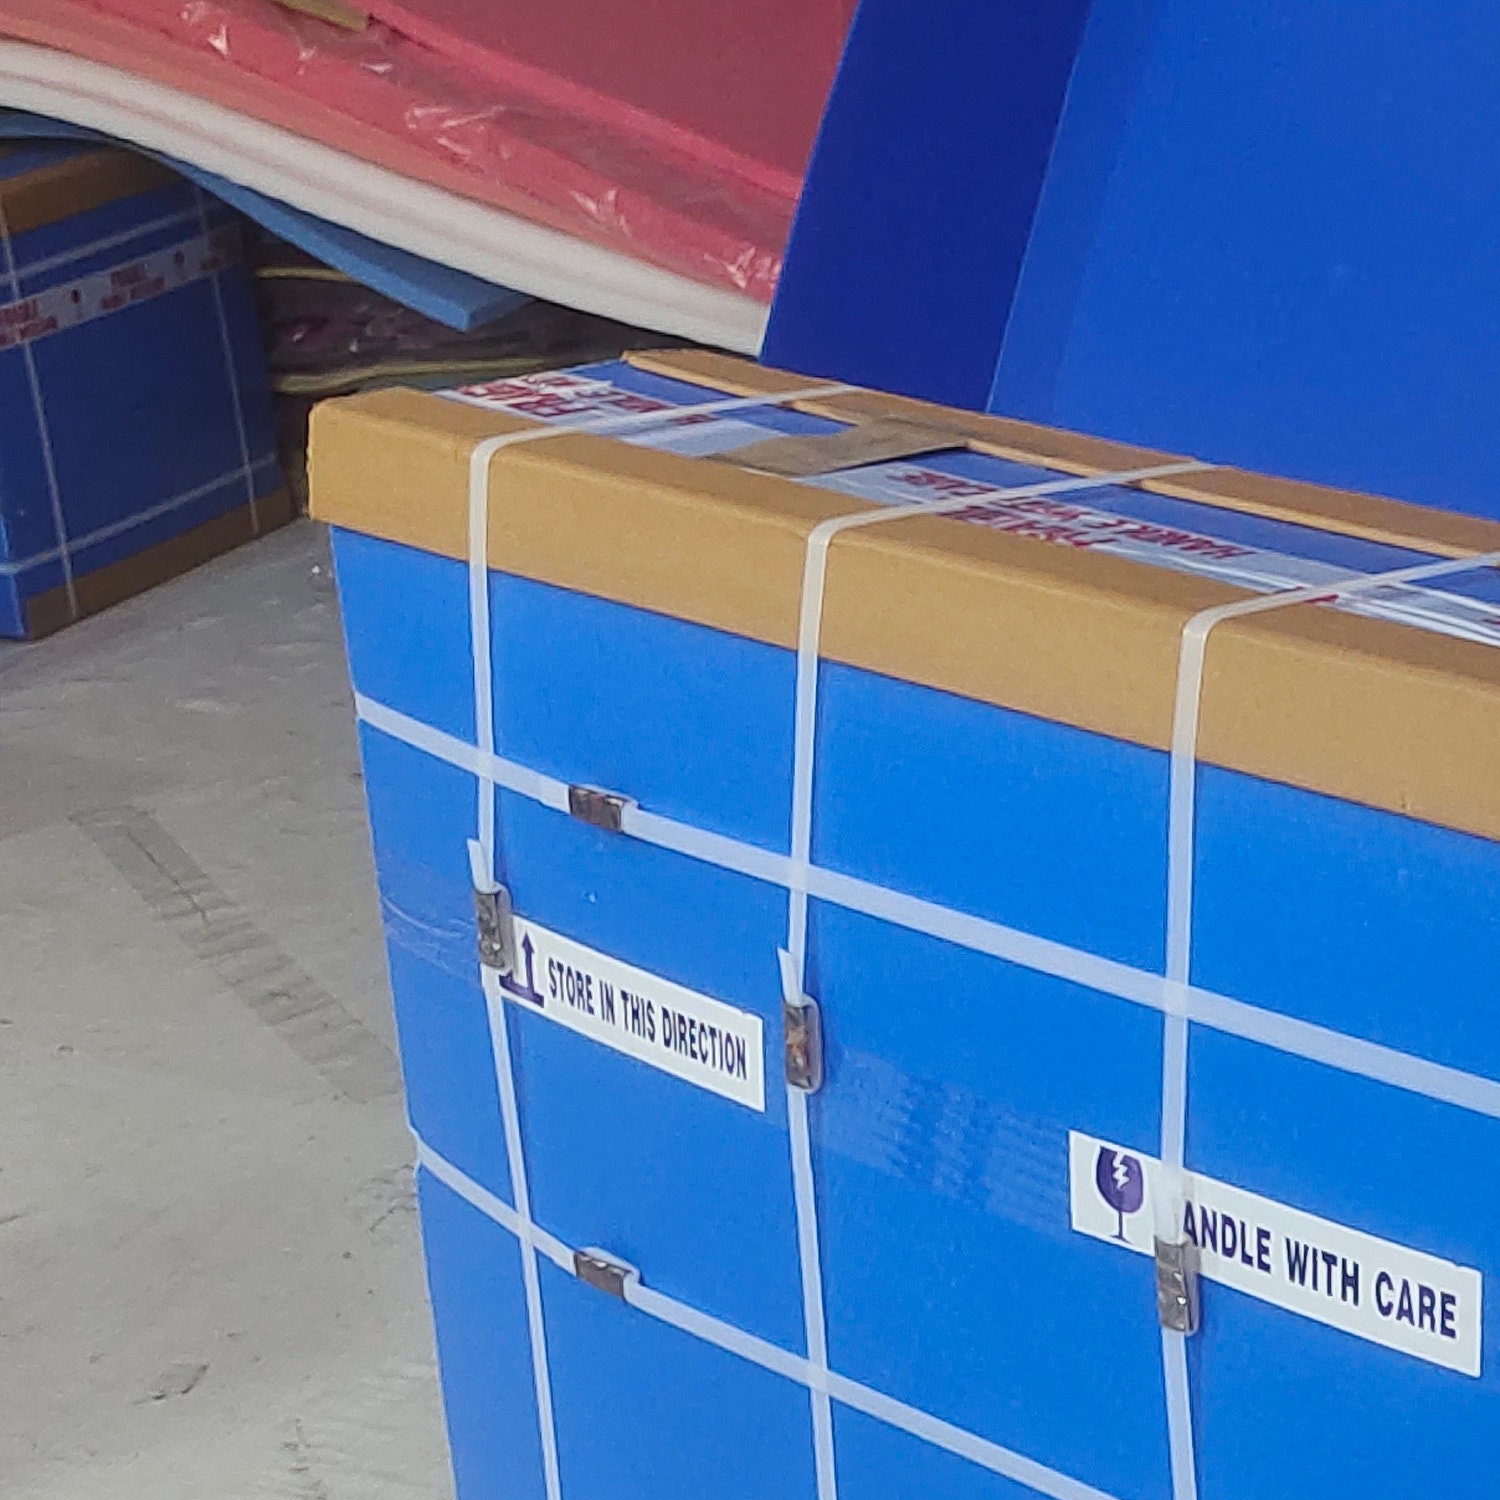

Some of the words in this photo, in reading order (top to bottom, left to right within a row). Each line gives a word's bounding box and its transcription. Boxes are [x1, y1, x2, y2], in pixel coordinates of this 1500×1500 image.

[548, 956, 595, 1016] STORE
[599, 979, 616, 1027] IN
[621, 989, 657, 1045] THIS
[661, 1005, 748, 1081] DIRECTION
[1181, 1199, 1272, 1275] ANDLE
[1285, 1236, 1361, 1307] WITH
[1375, 1270, 1458, 1340] CARE
